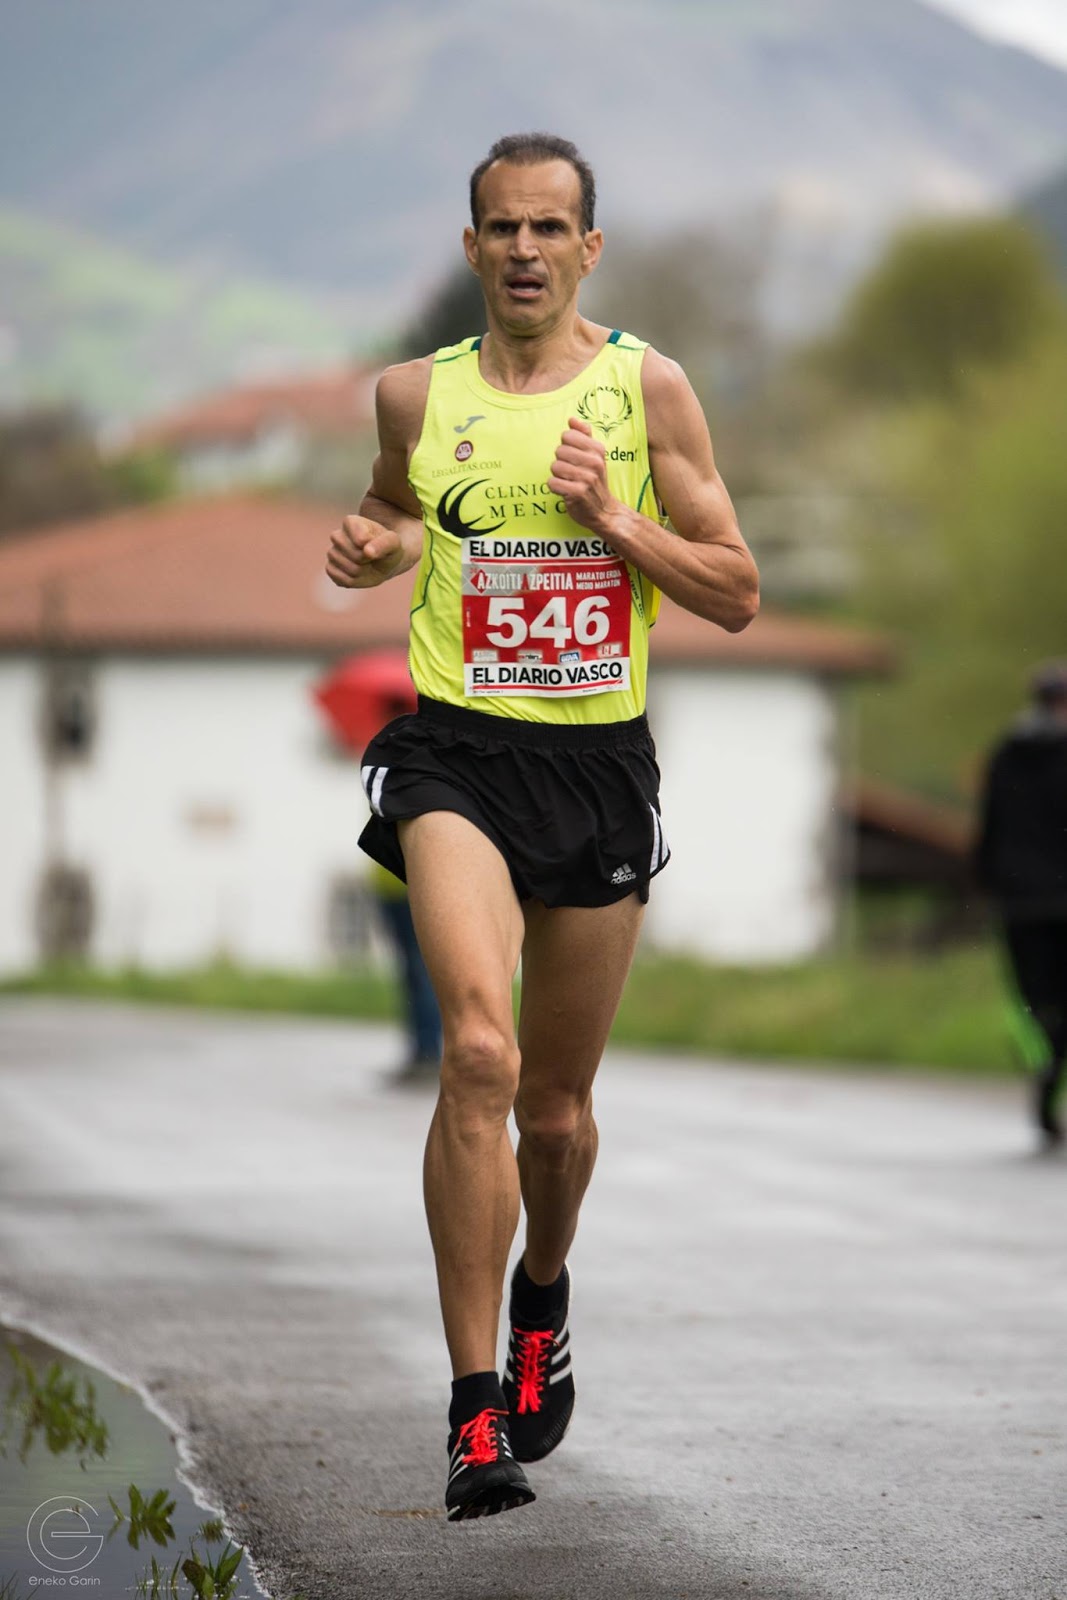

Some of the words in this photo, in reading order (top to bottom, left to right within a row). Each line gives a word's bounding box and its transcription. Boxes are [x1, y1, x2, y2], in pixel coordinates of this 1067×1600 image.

[469, 540, 490, 557] EL
[493, 541, 561, 557] DIARIO
[564, 540, 617, 557] VASC
[575, 581, 594, 590] MEDIO
[485, 595, 611, 648] 546
[472, 667, 495, 684] EL
[498, 667, 563, 685] DIARIO
[565, 662, 623, 684] VASCO
[610, 872, 637, 885] adidas
